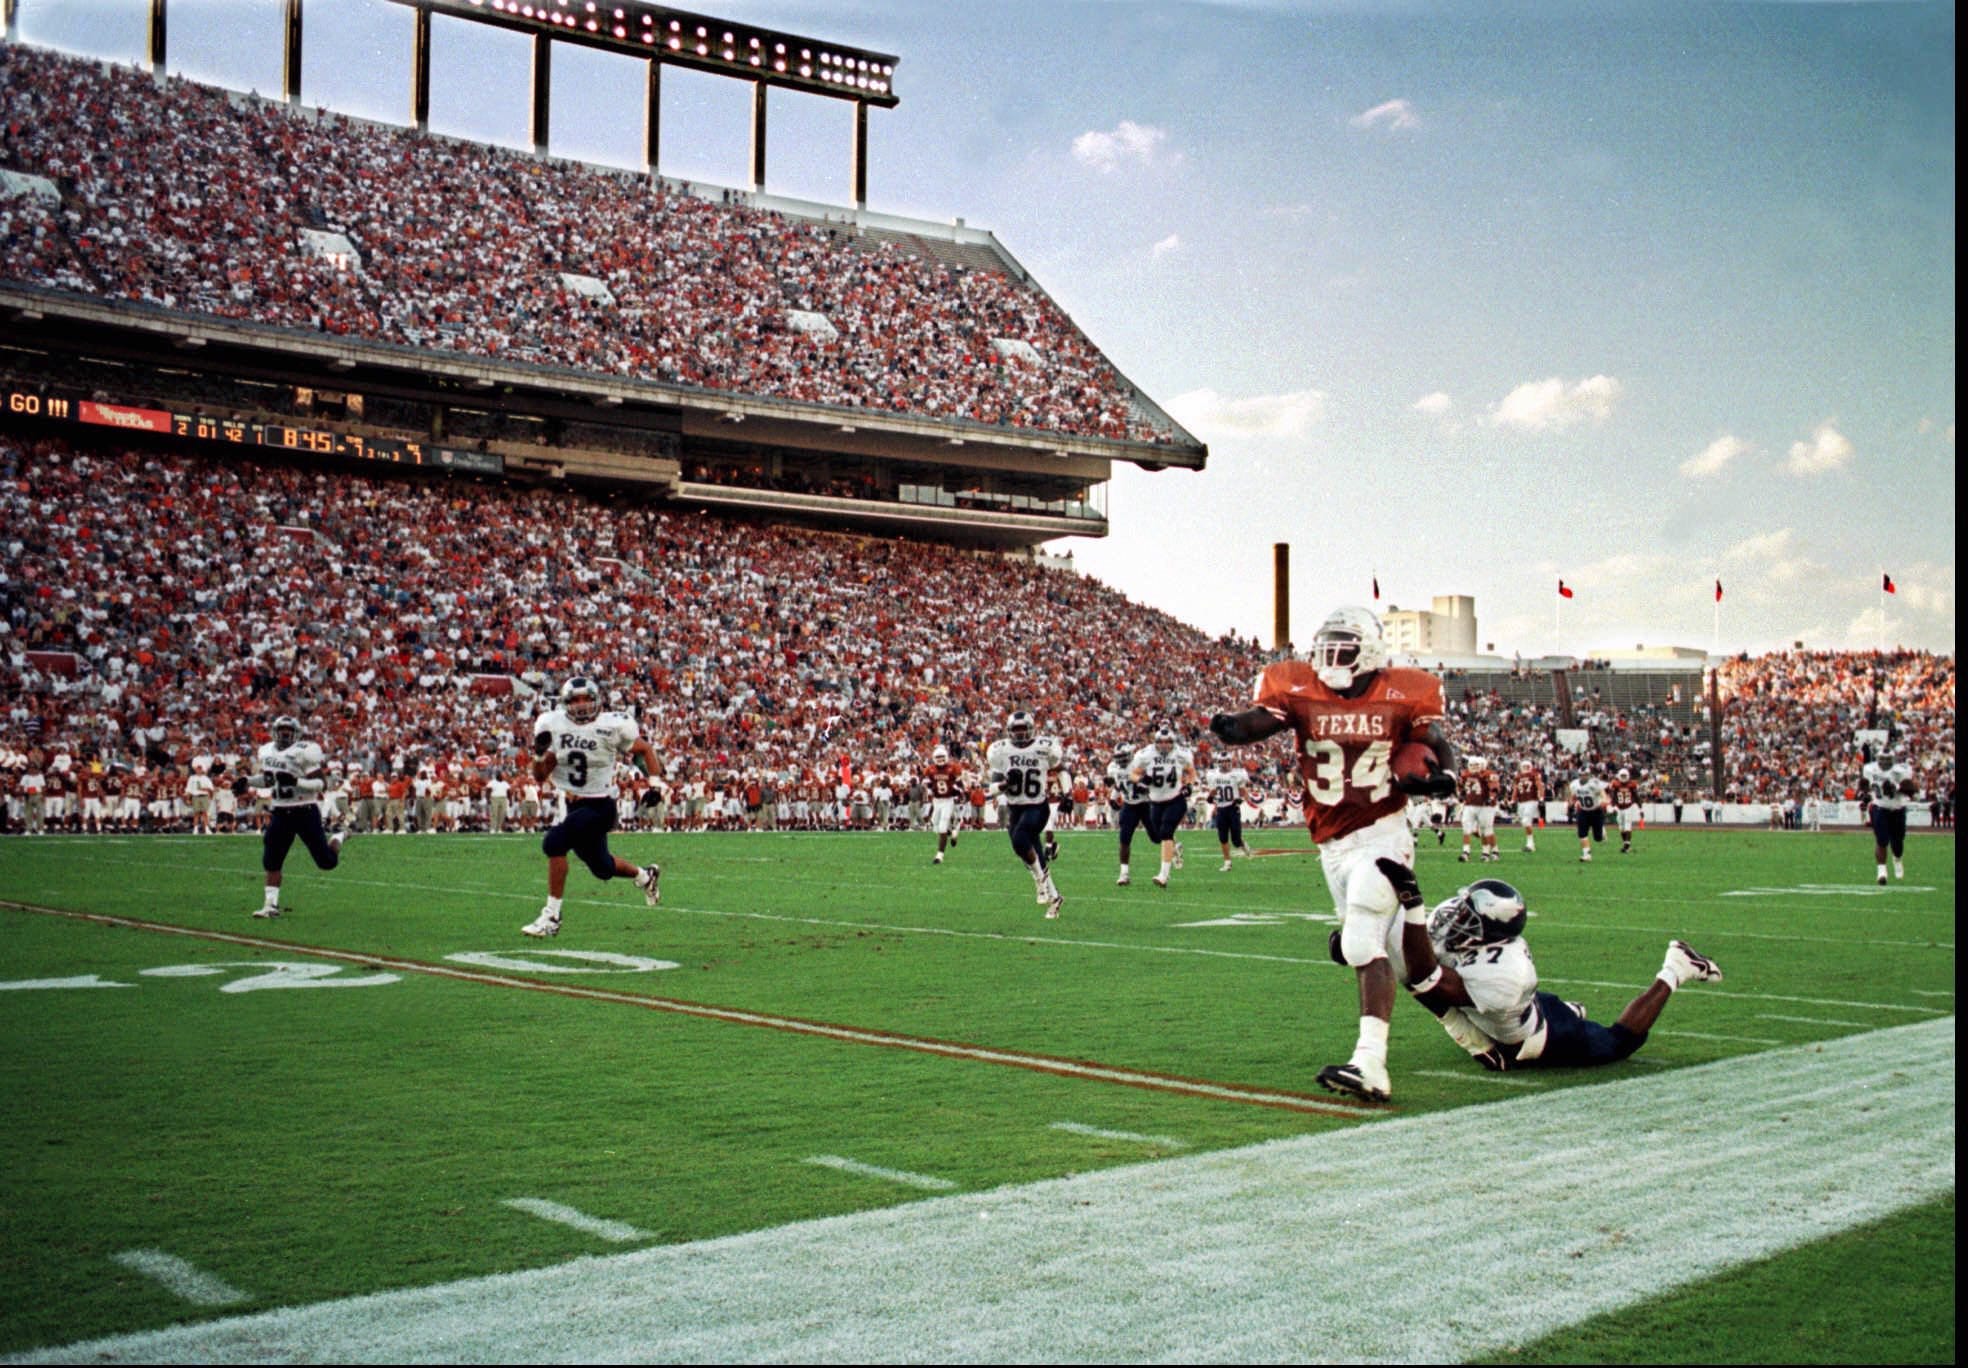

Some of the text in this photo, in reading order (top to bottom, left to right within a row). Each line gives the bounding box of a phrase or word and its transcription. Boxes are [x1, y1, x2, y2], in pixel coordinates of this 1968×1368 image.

[10, 393, 69, 418] GO !!!
[177, 422, 187, 436] 2
[197, 424, 217, 439] 01
[224, 428, 243, 442] 42
[1317, 714, 1384, 736] TEXAS
[559, 733, 597, 751] Rice
[567, 750, 588, 788] 3
[1009, 755, 1039, 767] Rice
[1305, 739, 1393, 807] 34
